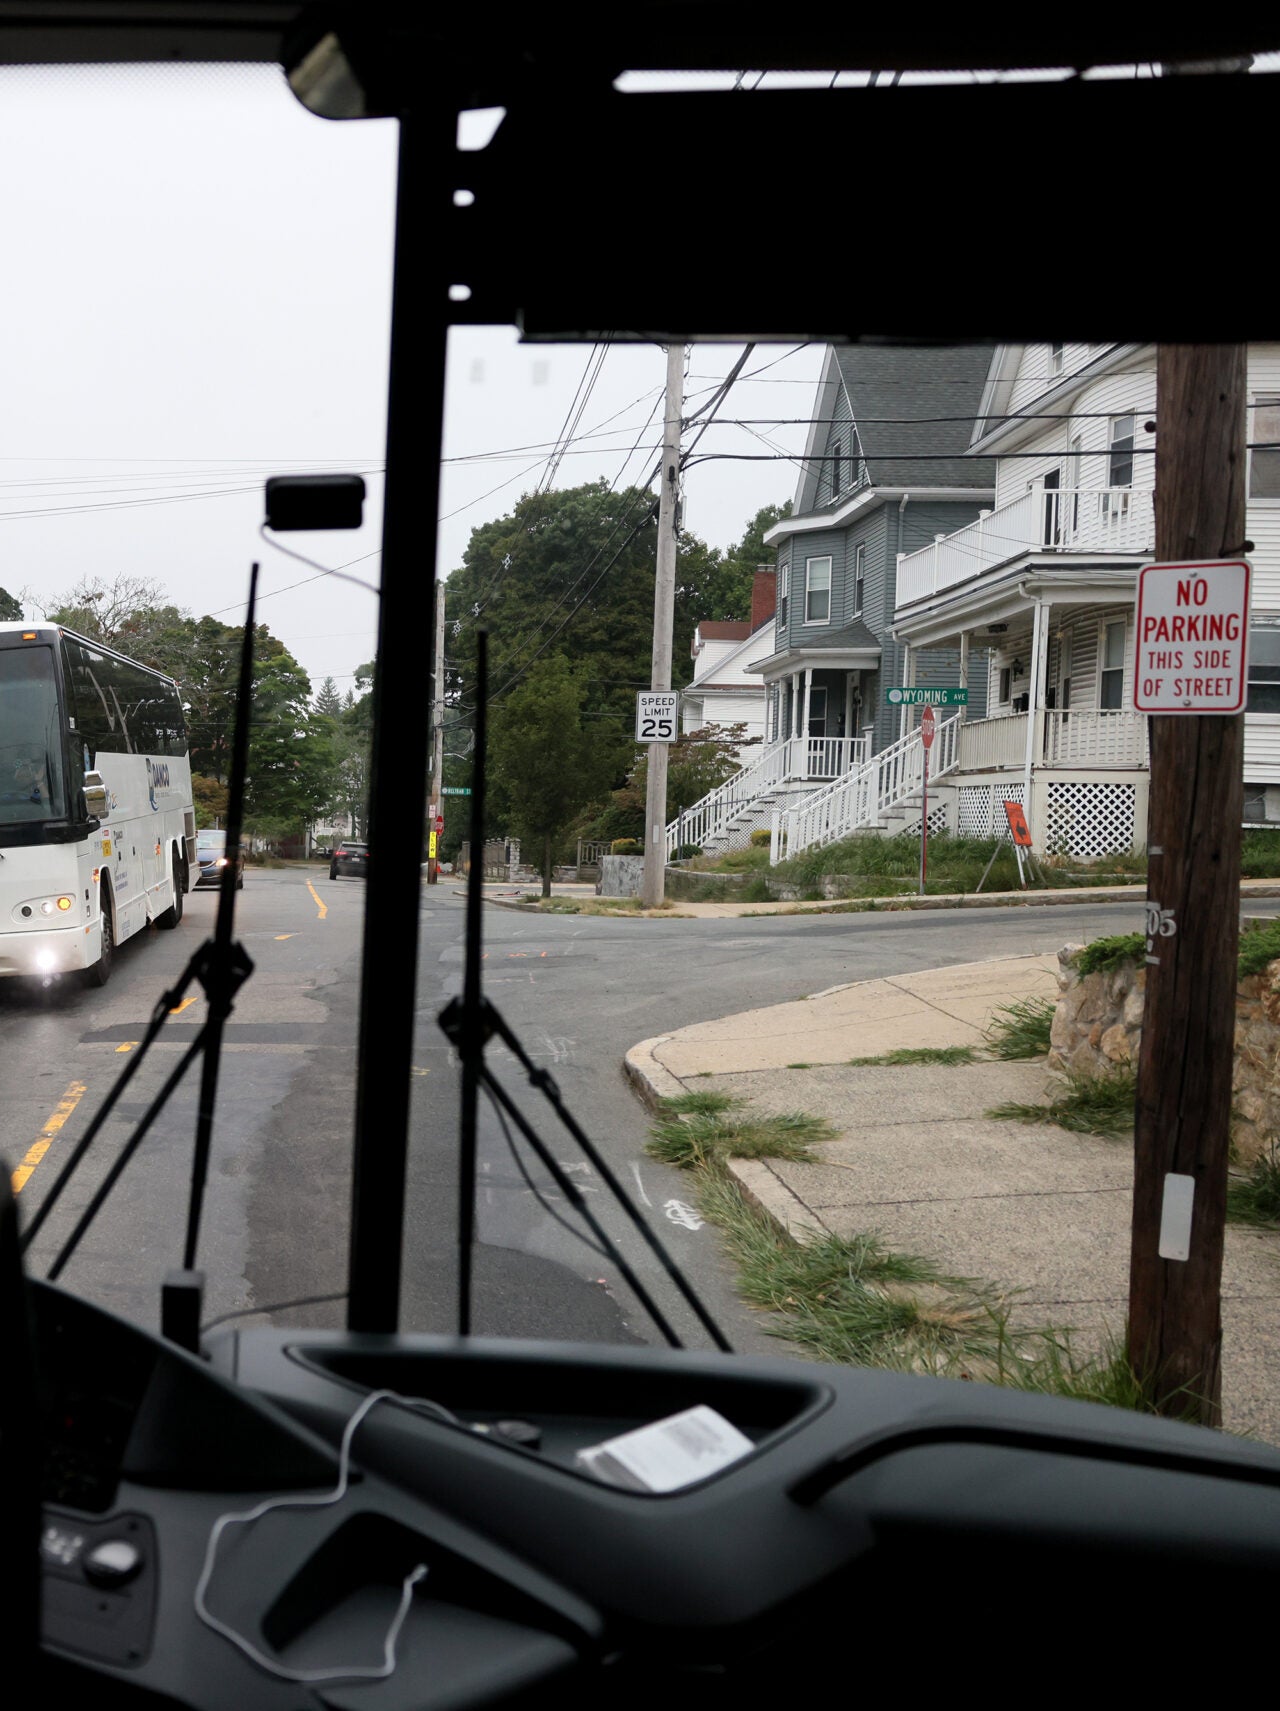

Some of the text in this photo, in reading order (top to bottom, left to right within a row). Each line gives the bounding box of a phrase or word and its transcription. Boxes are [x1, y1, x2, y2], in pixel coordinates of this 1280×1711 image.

[1176, 579, 1208, 606] NO
[1144, 613, 1240, 643] PARKING
[1148, 650, 1231, 669] THIS SIDE
[902, 690, 966, 703] WYOMING AVE
[1143, 677, 1233, 697] OF STREET
[641, 696, 675, 706] SPEED
[644, 708, 670, 717] LIMIT
[641, 719, 673, 739] 25
[922, 719, 935, 736] STOP
[1148, 910, 1176, 936] 05
